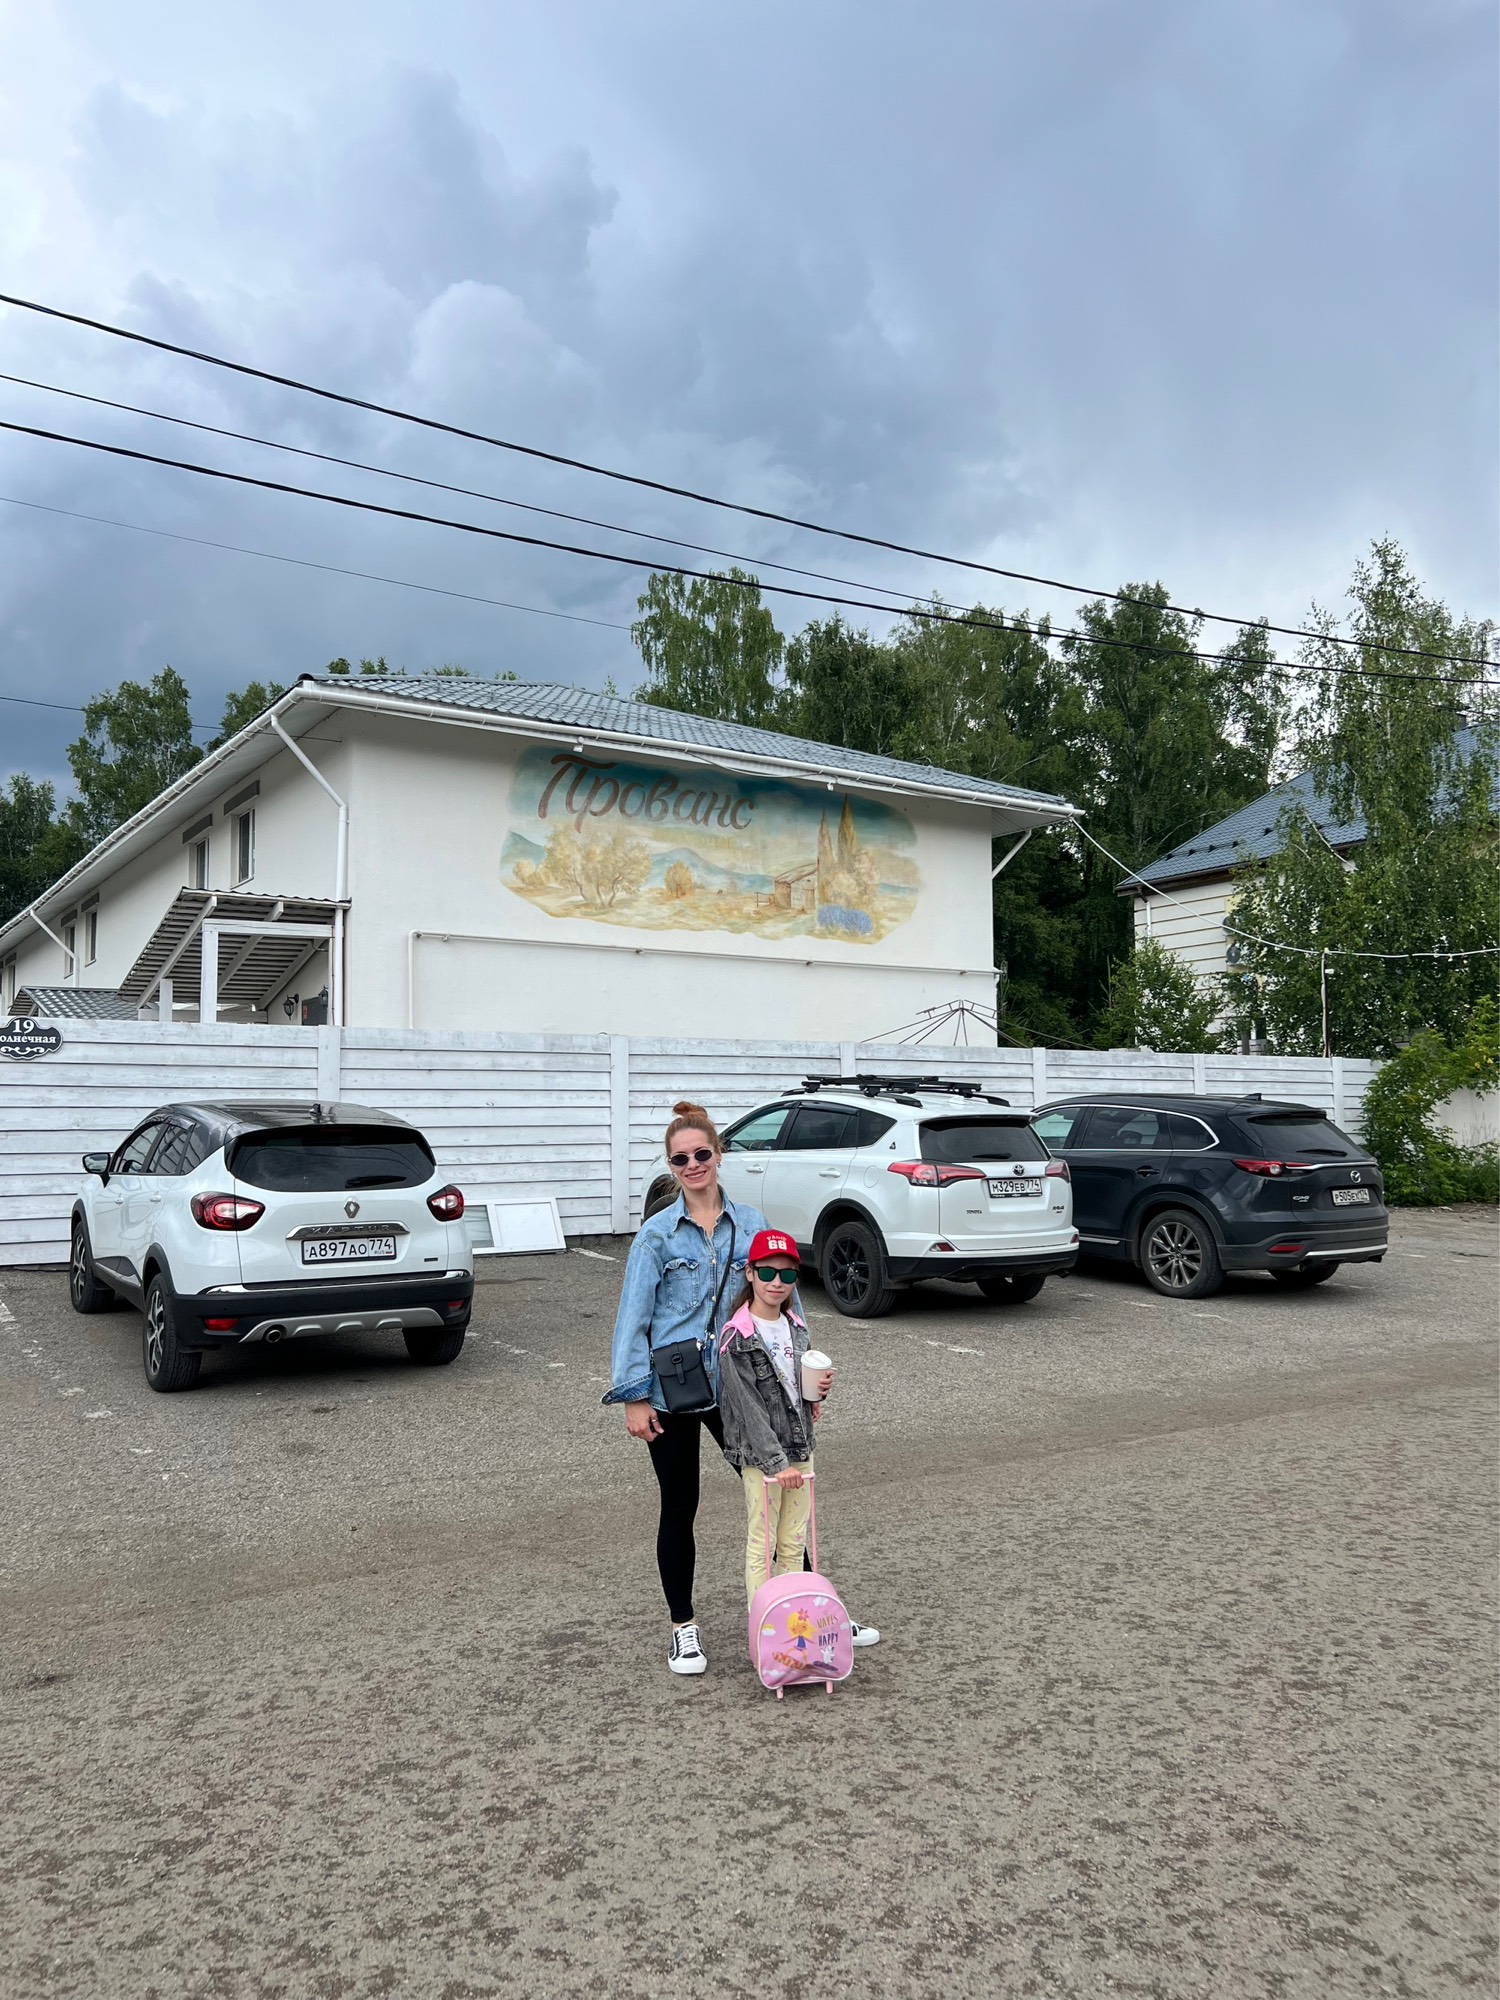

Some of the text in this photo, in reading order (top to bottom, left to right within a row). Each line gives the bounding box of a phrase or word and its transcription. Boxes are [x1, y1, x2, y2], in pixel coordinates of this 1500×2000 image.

[537, 754, 755, 833] Прованс
[12, 1019, 35, 1034] 19
[0, 1035, 57, 1044] олнечная
[1025, 1179, 1039, 1188] 774
[309, 1238, 391, 1258] А897АО 774
[818, 1632, 838, 1646] HAPPY
